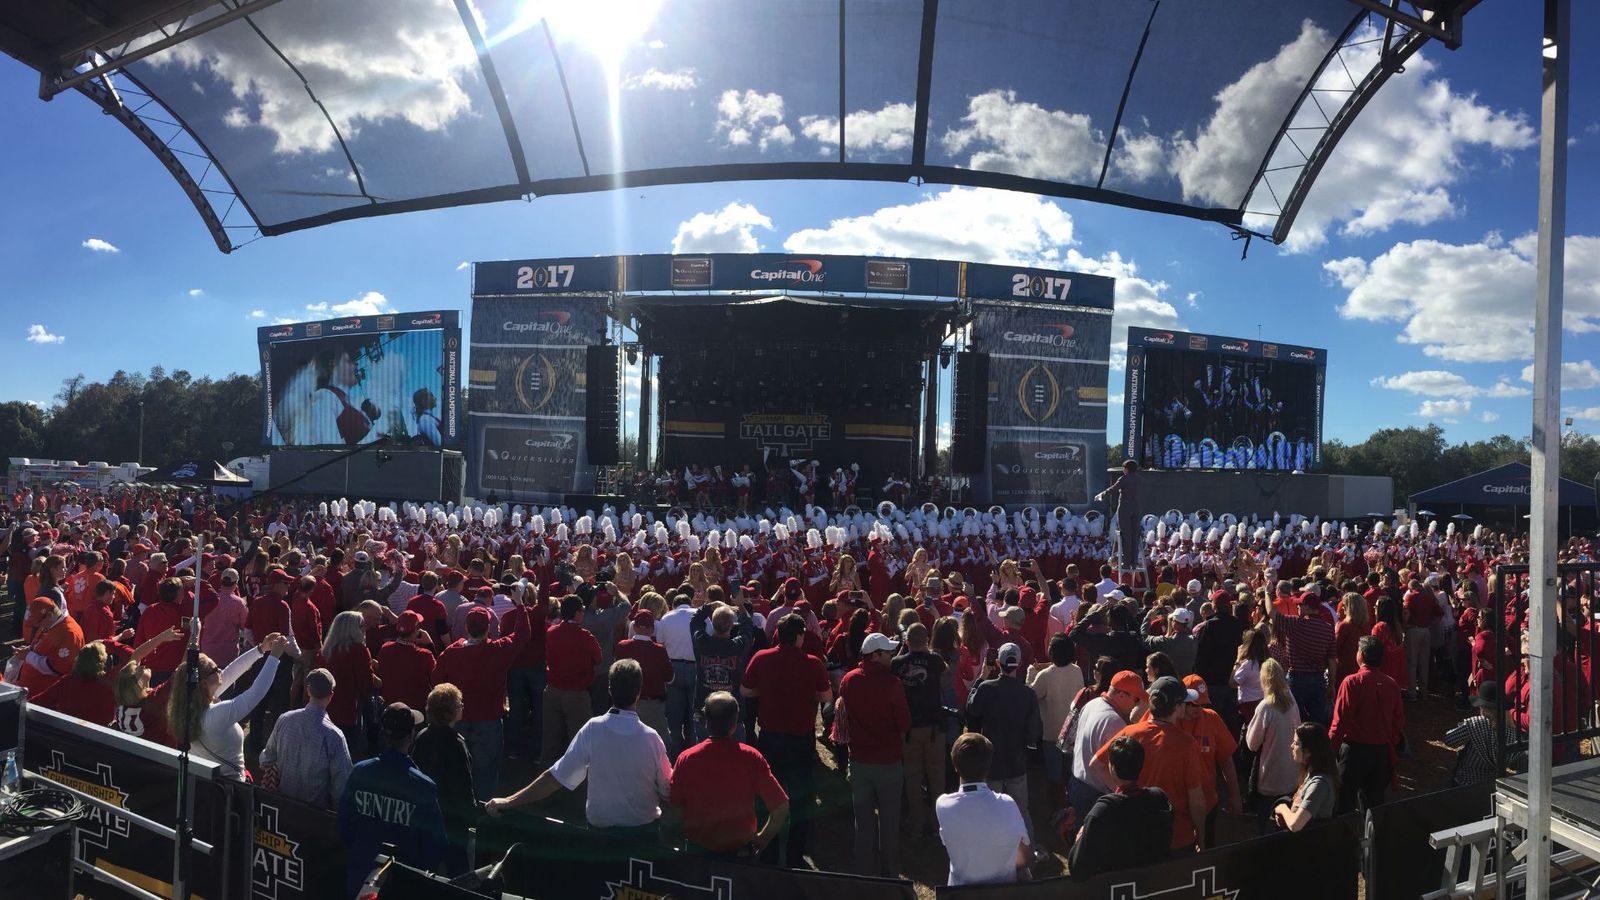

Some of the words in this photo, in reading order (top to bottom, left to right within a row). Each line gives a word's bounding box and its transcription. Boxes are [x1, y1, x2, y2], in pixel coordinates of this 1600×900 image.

[517, 265, 574, 289] 2017
[1012, 273, 1072, 300] 2017
[743, 424, 829, 438] TAILGATE
[1482, 484, 1531, 495] CapitalO
[355, 790, 417, 827] SENTRY
